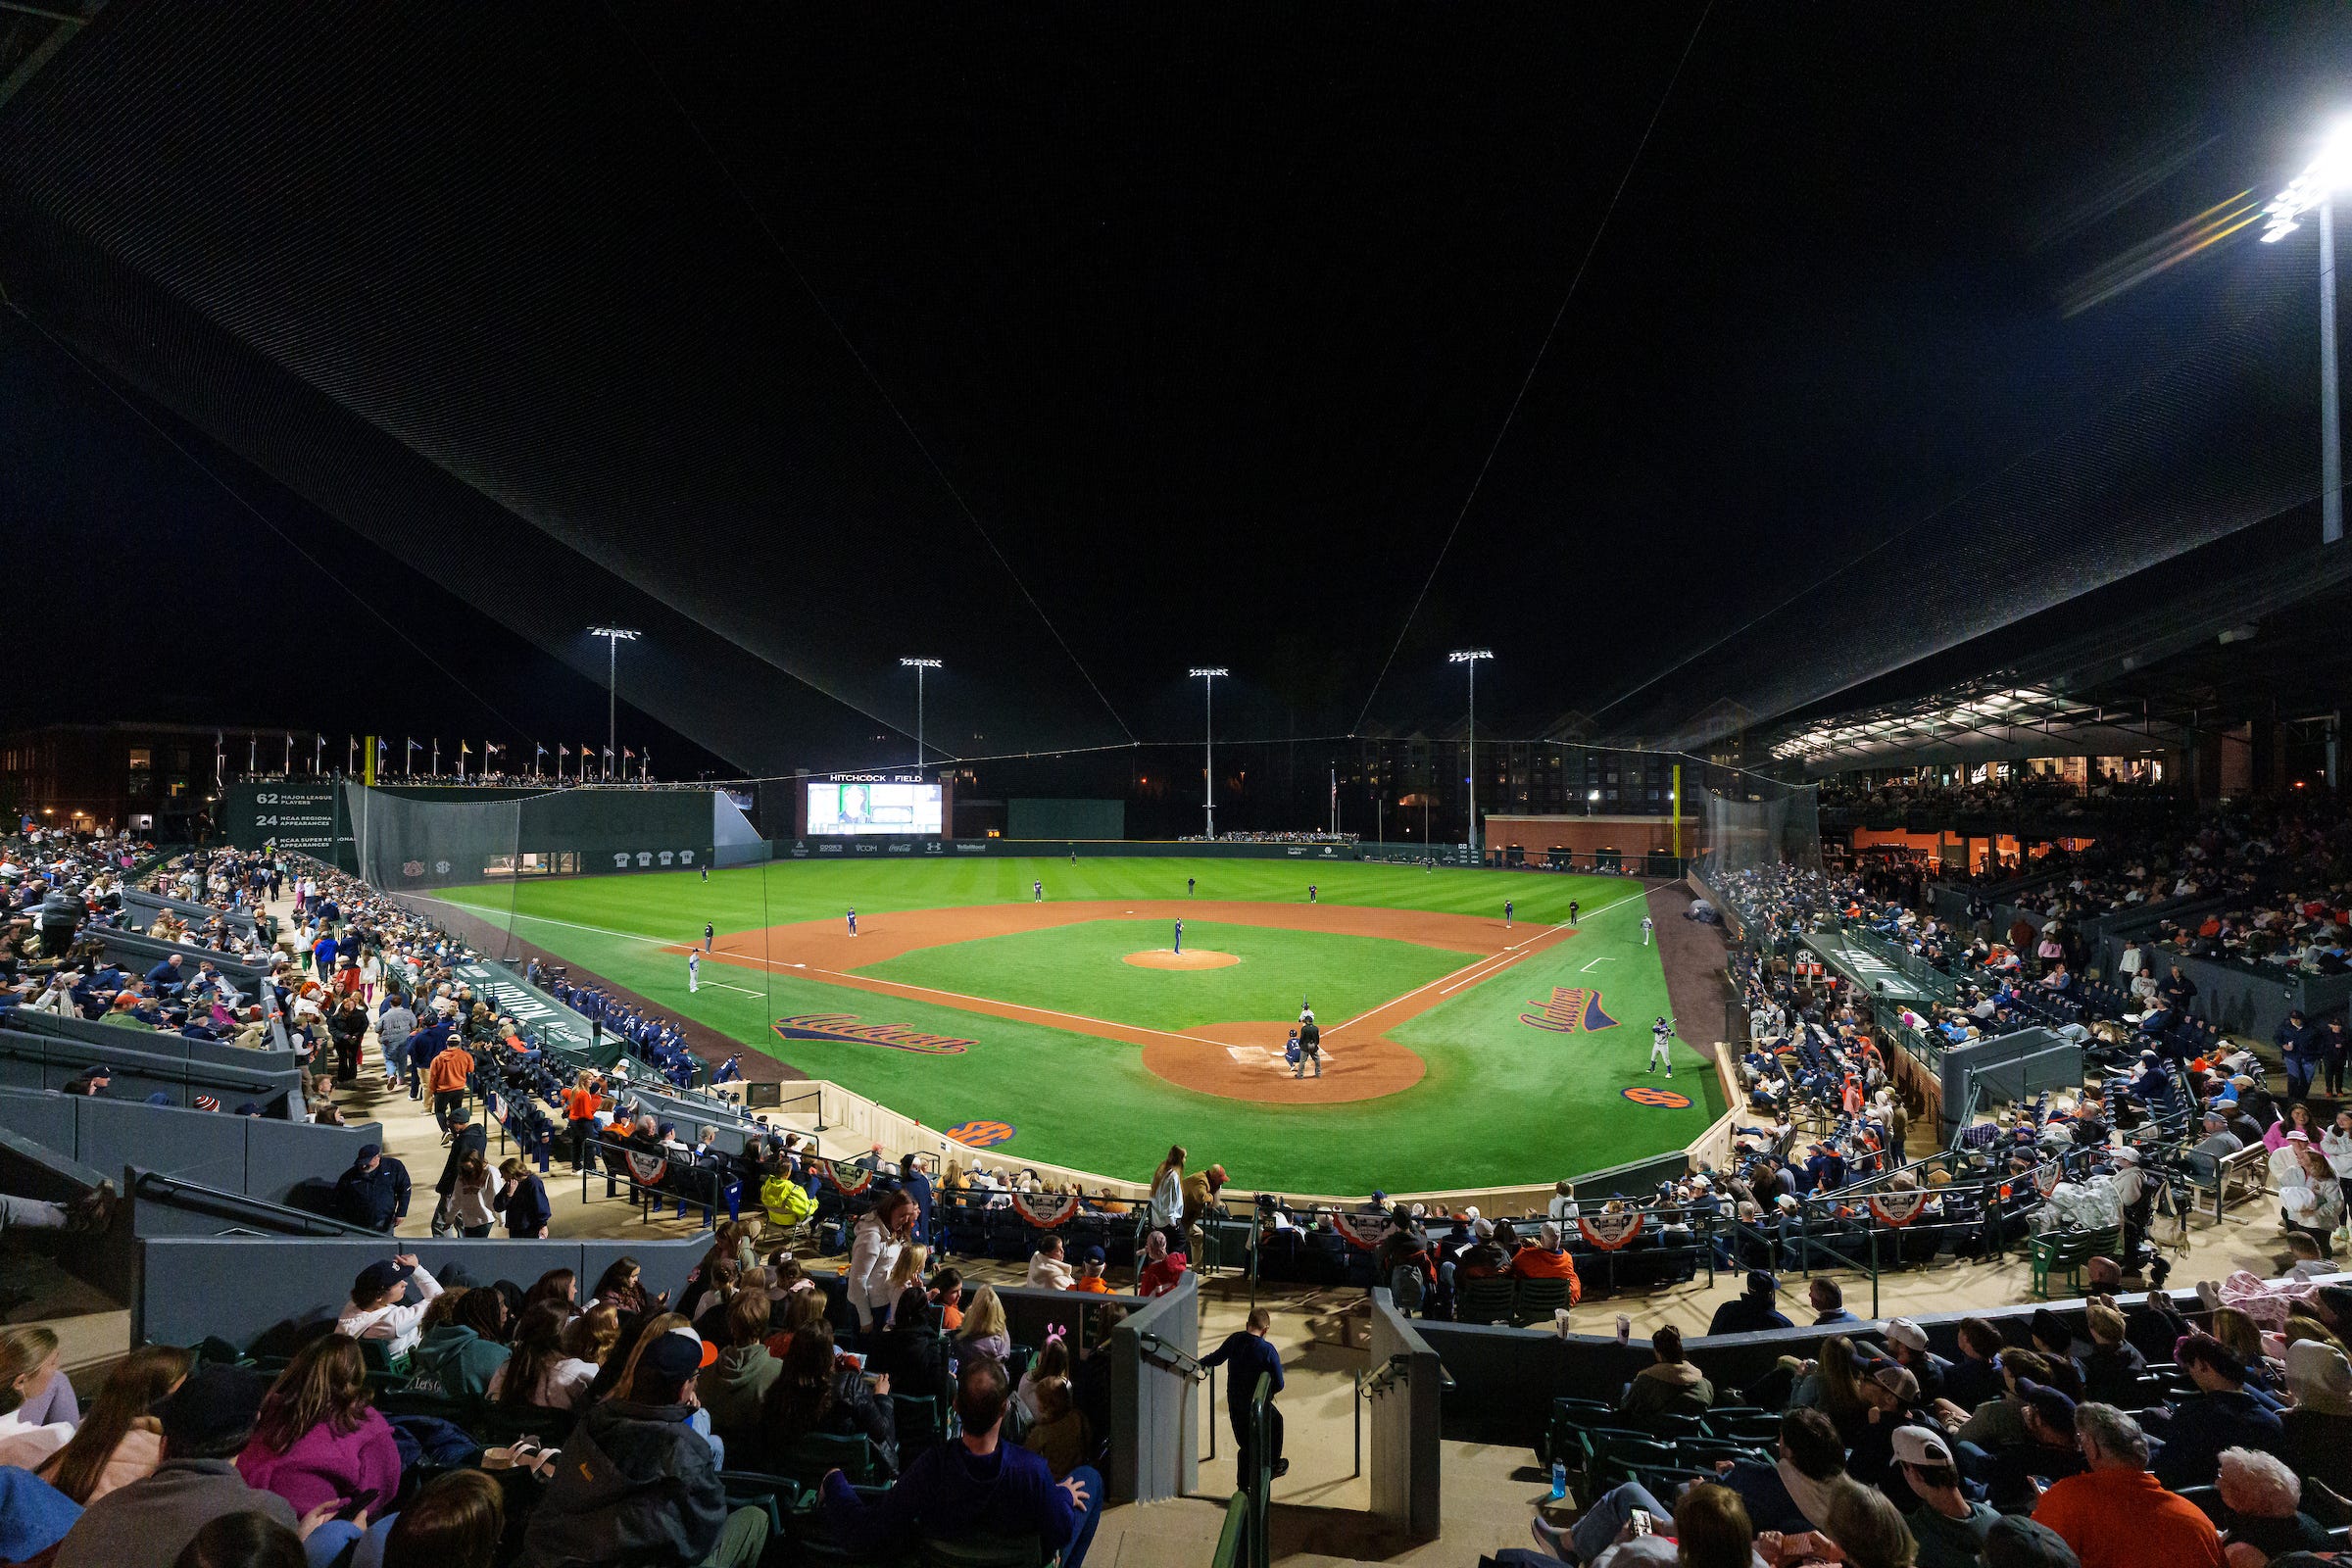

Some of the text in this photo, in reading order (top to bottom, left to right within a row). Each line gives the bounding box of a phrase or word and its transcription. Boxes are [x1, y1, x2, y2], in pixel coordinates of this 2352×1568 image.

[256, 793, 278, 805] 62
[256, 814, 278, 826] 24
[435, 860, 451, 874] SEC
[946, 1120, 1015, 1147] SEC
